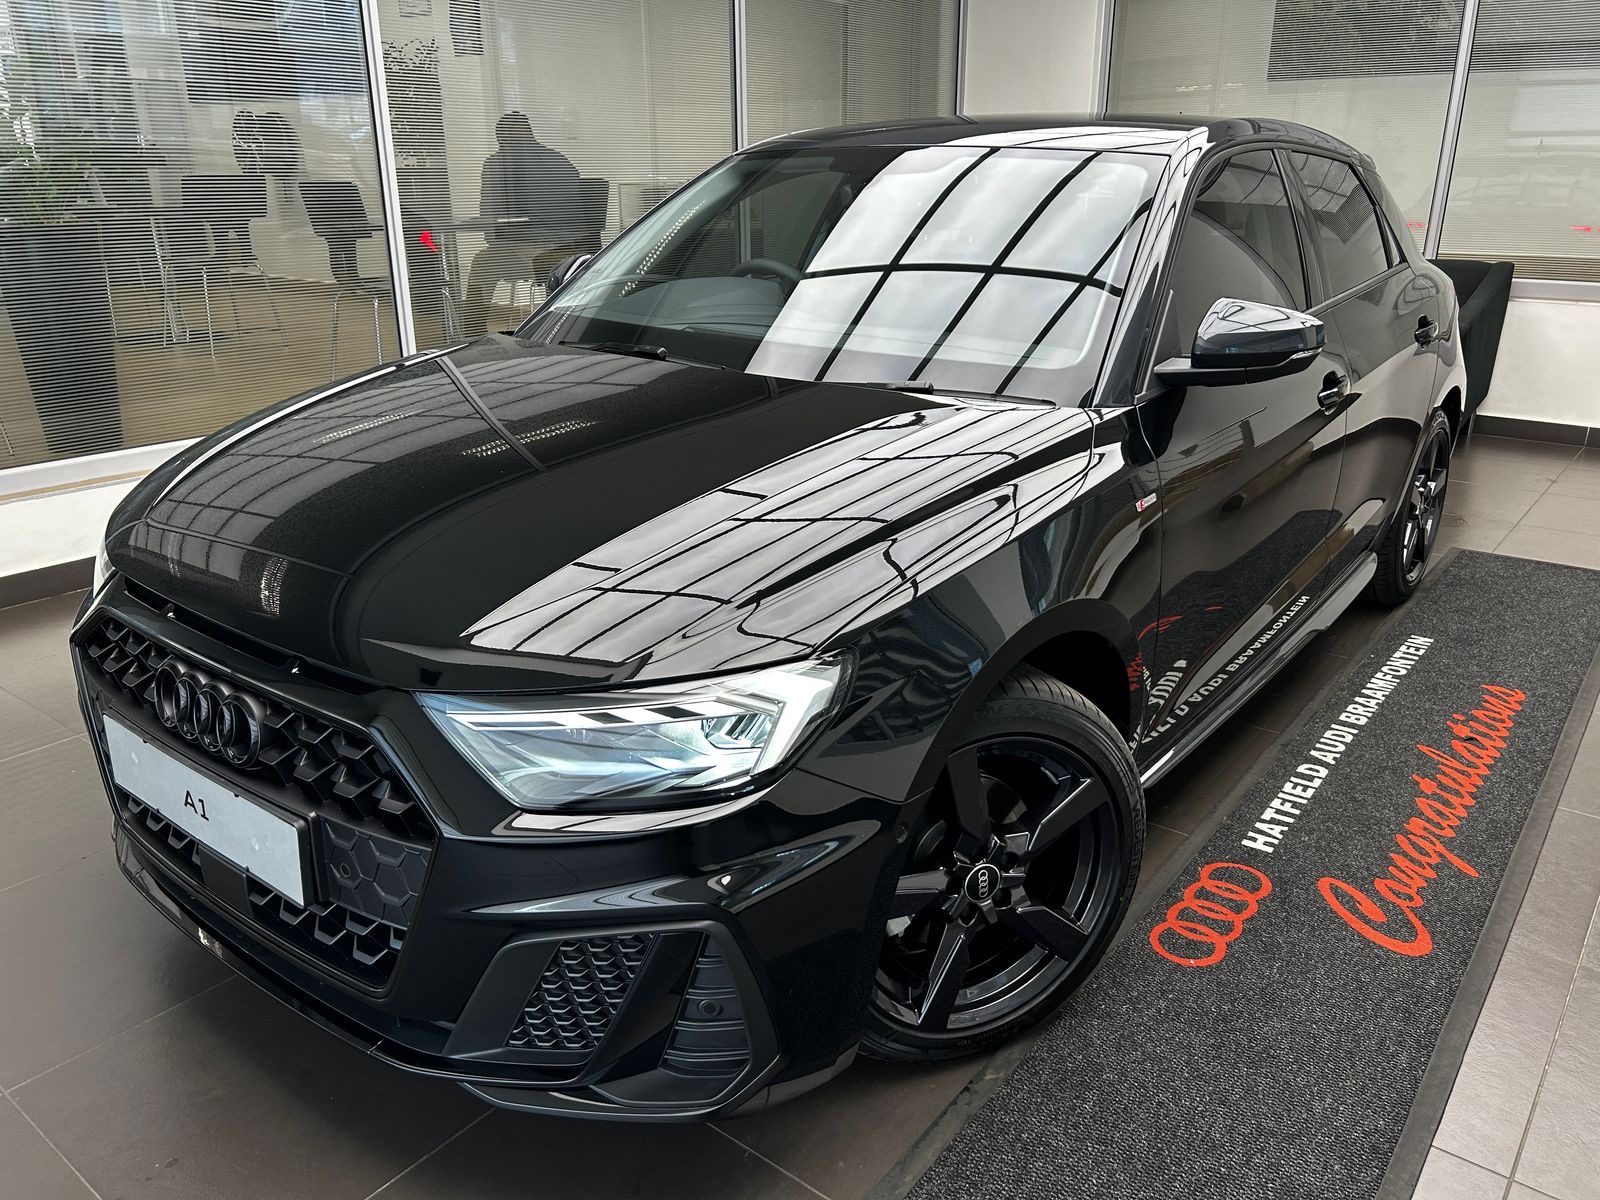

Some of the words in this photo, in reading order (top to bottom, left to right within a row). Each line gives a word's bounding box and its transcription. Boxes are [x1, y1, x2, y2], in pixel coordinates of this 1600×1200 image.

[184, 790, 210, 821] A1
[1241, 763, 1329, 854] HATFIELD
[1309, 723, 1359, 765] AUDI
[1338, 634, 1435, 726] BRAAMFONTEIN
[1316, 684, 1527, 957] Congratulations
